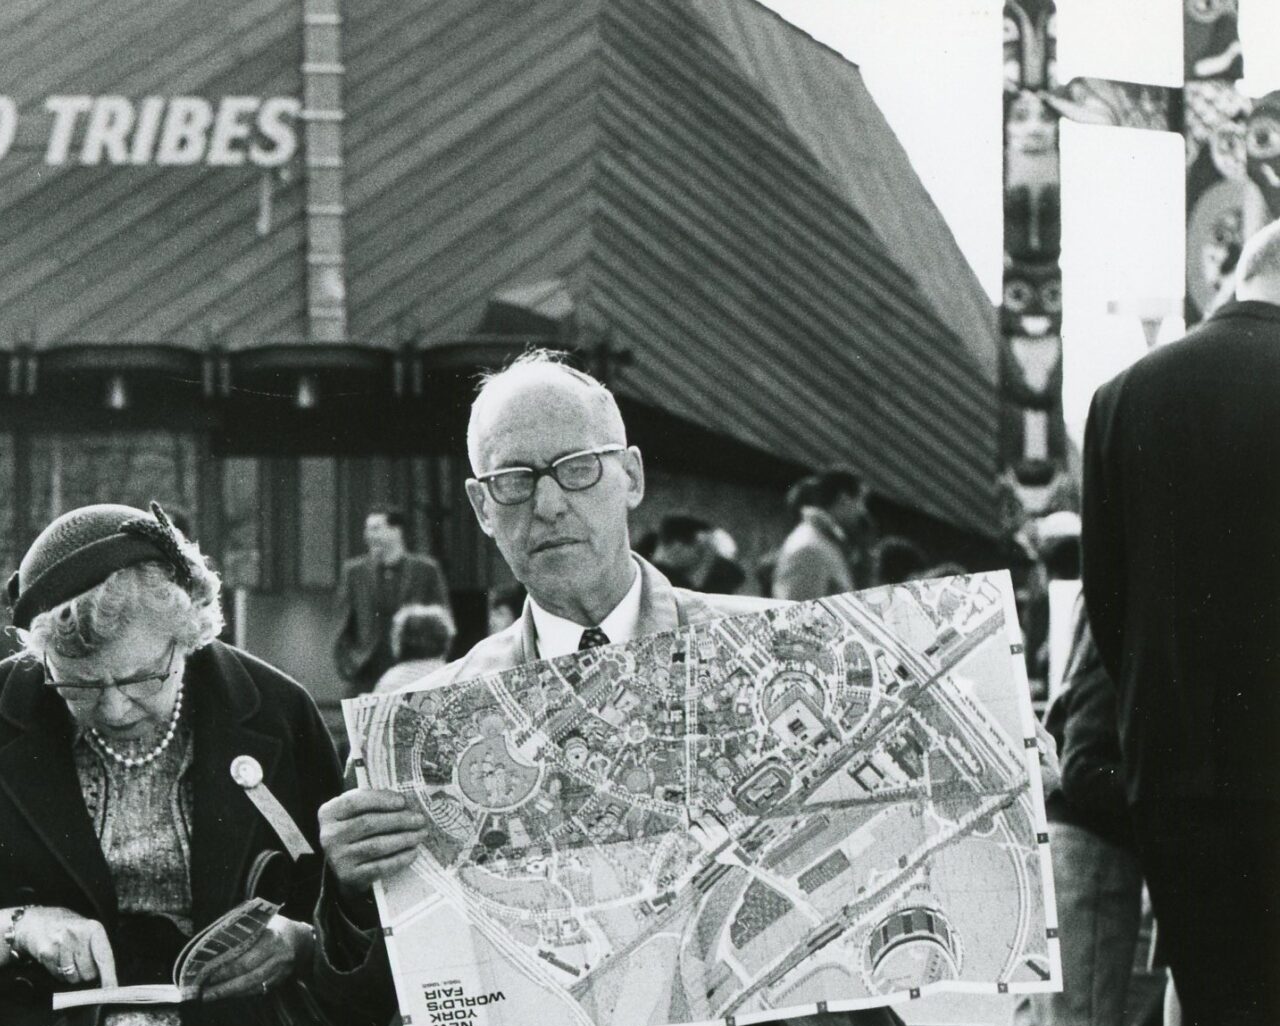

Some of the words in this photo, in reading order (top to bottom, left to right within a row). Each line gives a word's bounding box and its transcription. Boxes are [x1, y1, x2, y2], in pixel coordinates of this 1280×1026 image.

[44, 93, 304, 168] TRIBES
[424, 986, 464, 1000] FAIR
[426, 991, 506, 1012] WORLD'S
[429, 1008, 478, 1023] YORK
